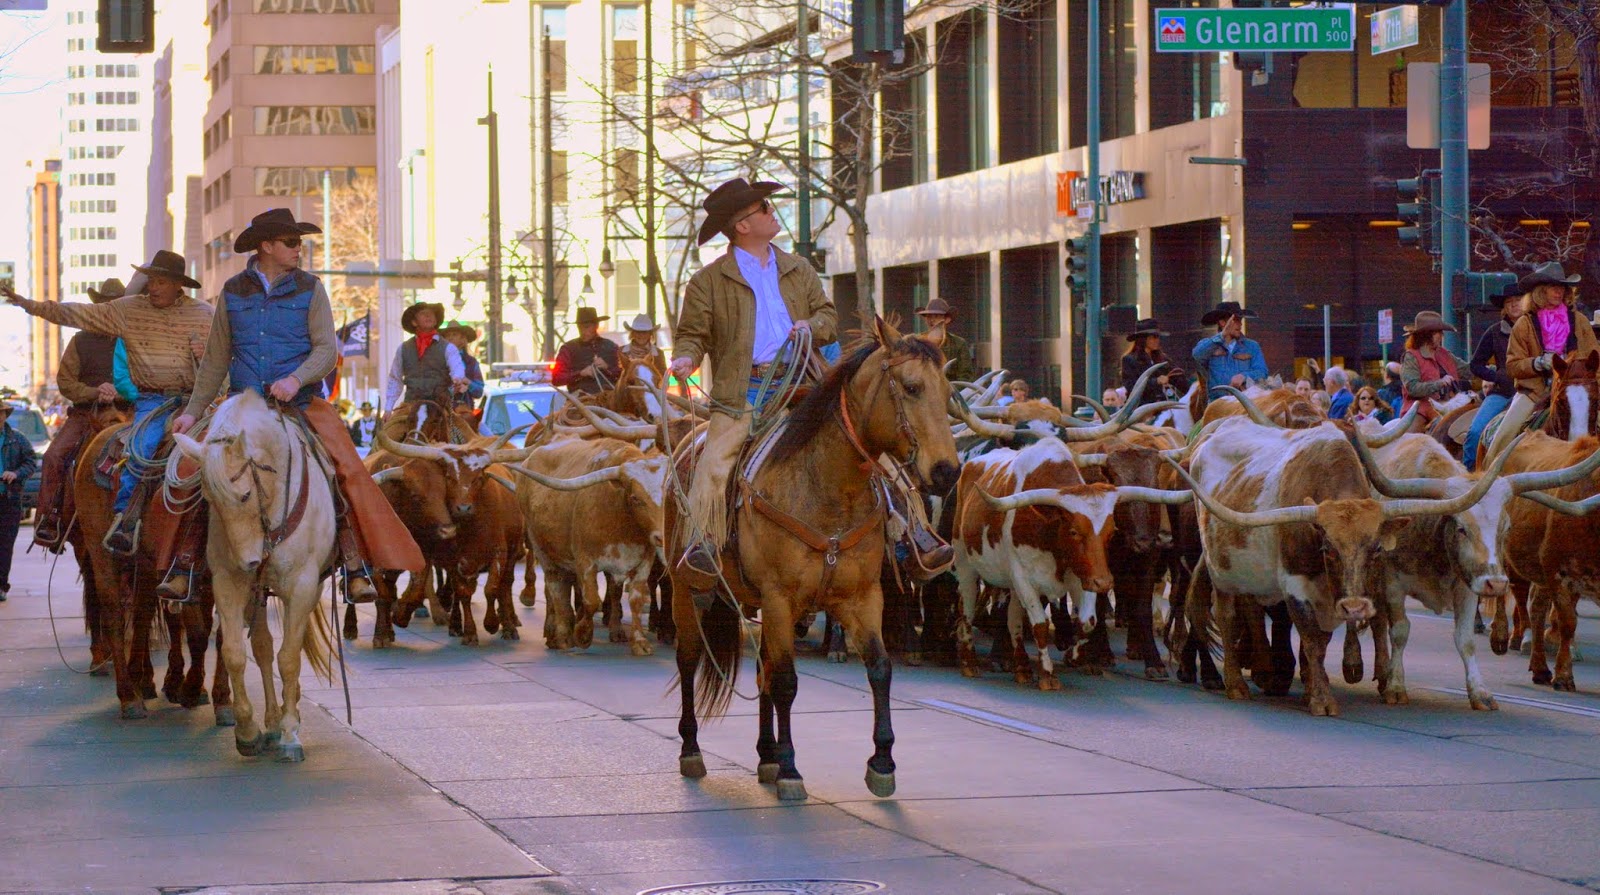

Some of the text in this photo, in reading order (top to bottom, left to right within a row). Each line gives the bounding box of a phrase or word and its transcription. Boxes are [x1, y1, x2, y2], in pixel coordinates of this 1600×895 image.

[1196, 16, 1318, 44] Glenarm
[1331, 17, 1342, 28] Pl
[1382, 15, 1401, 43] 17th
[1161, 34, 1186, 43] DENVER
[1326, 31, 1348, 42] 500
[1110, 172, 1136, 204] BANK
